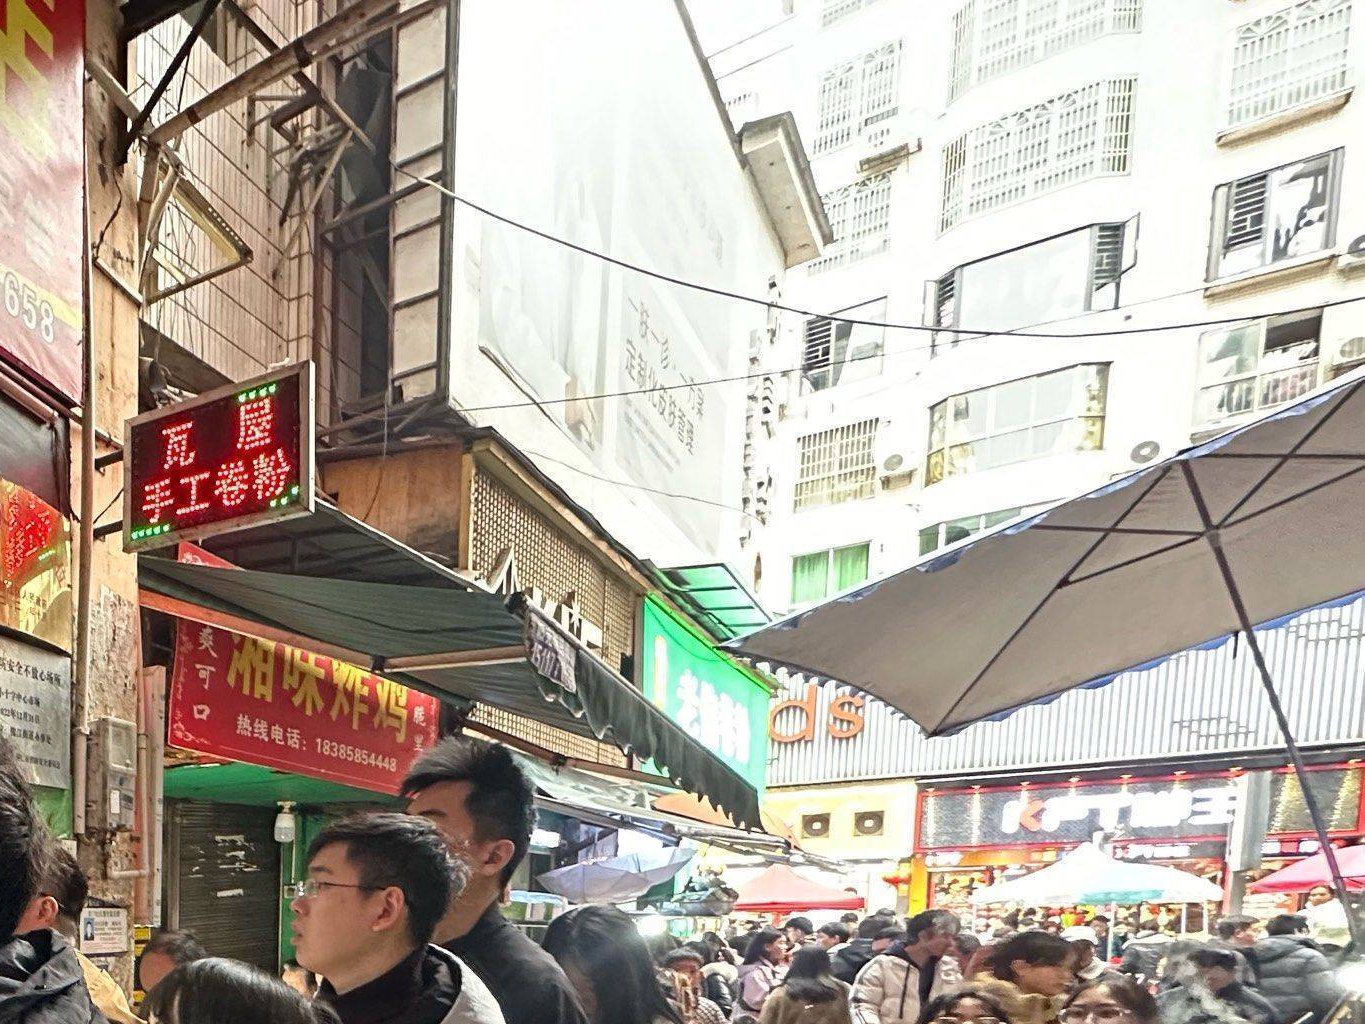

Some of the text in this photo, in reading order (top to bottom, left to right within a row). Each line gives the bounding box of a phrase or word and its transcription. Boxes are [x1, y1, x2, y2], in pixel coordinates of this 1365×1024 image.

[142, 448, 291, 524] 手工卷粉
[227, 633, 411, 744] 湘味炸鸡
